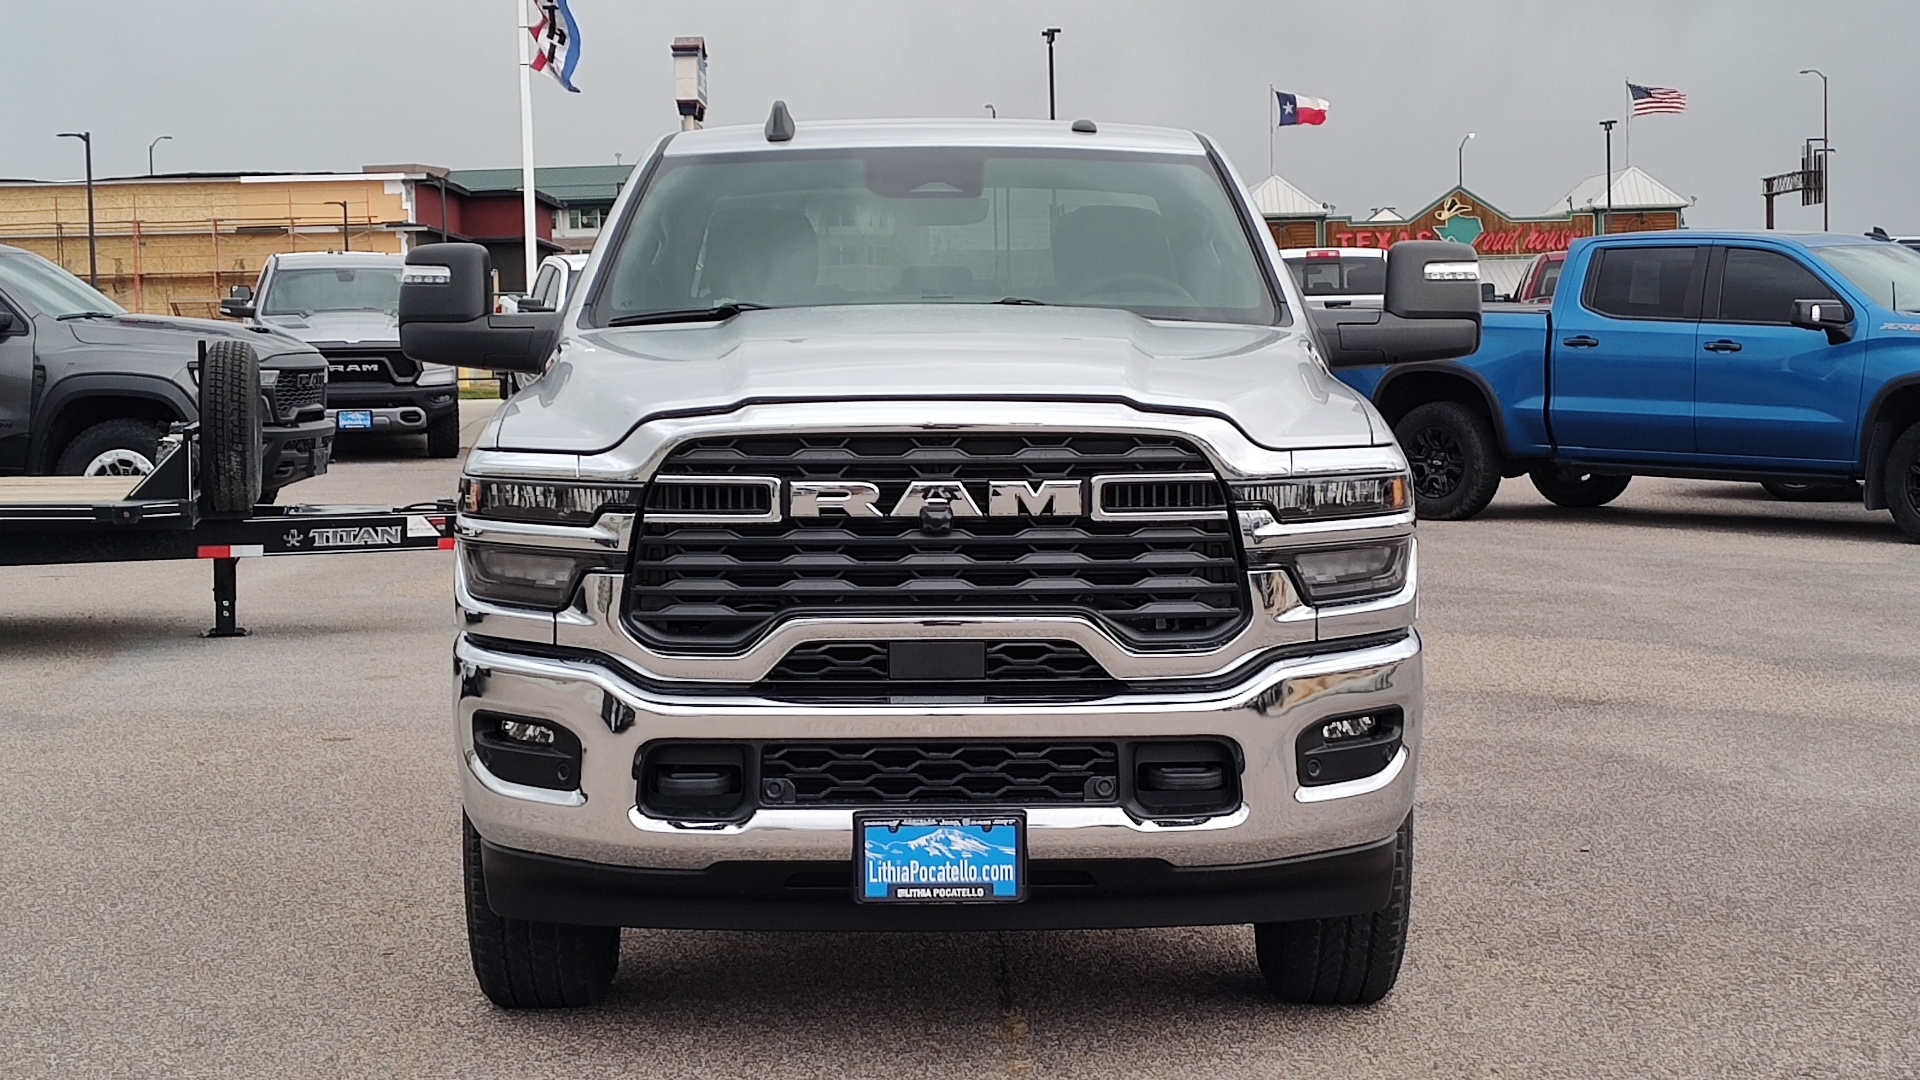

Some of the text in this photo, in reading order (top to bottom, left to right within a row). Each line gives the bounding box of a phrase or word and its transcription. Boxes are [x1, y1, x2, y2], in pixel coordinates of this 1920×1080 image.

[329, 364, 379, 372] RAM
[789, 480, 1083, 517] RAM
[308, 525, 403, 547] TITAN
[868, 859, 1014, 883] LithiaPocatello.com
[933, 887, 985, 897] POCATELLO
